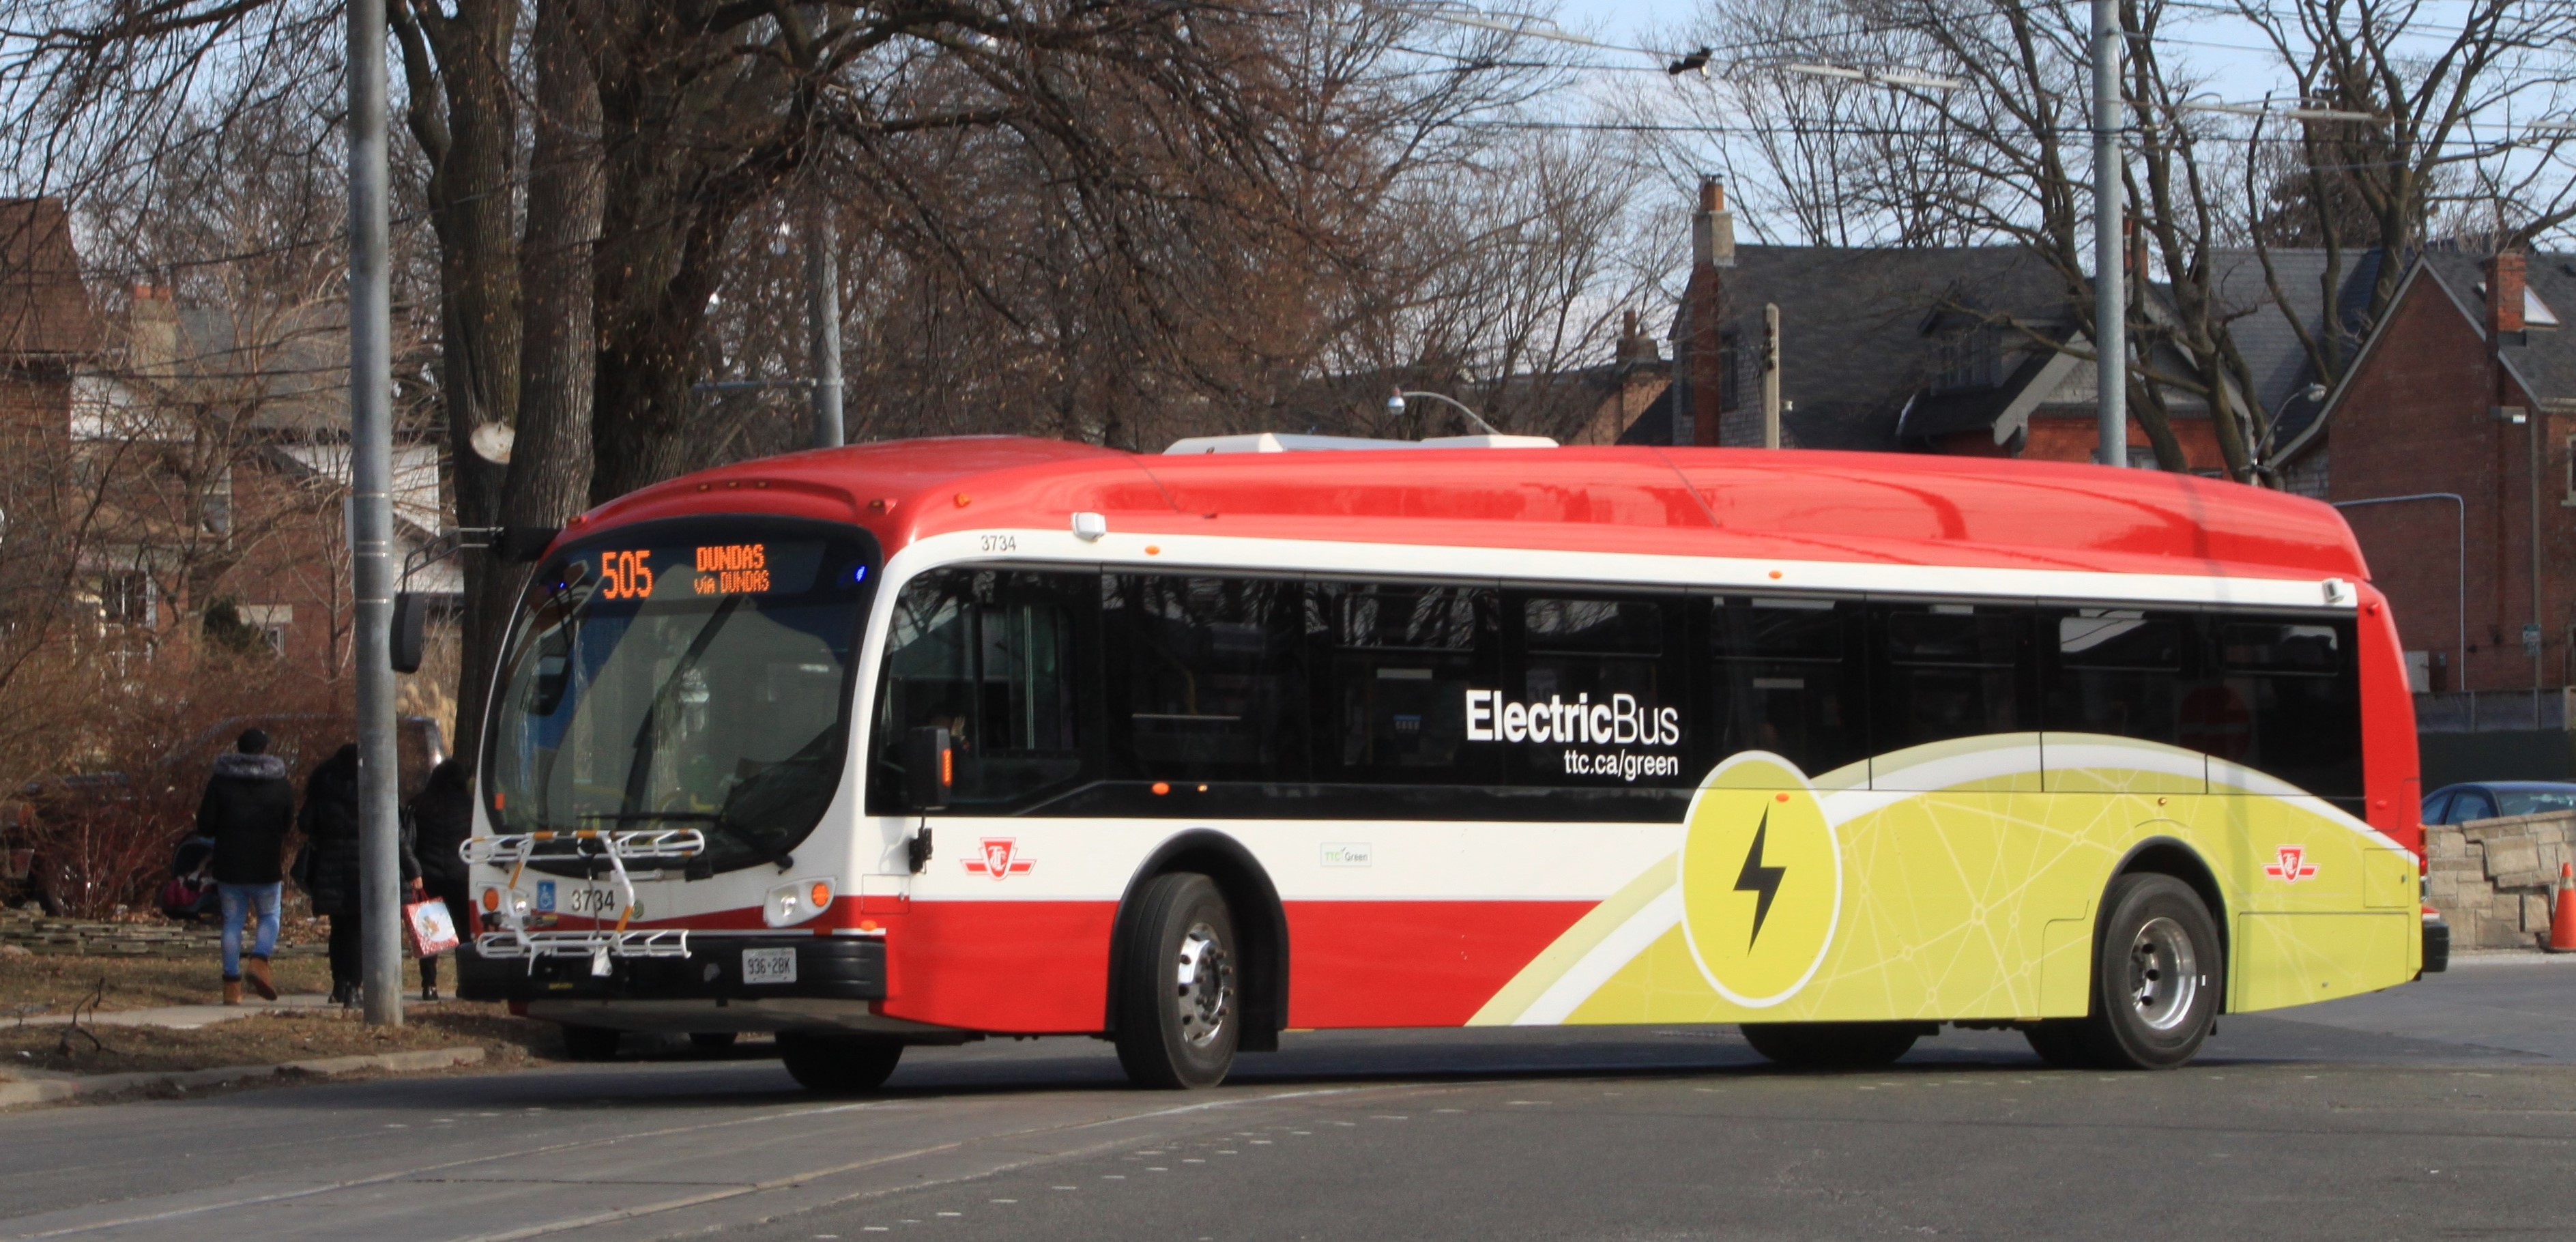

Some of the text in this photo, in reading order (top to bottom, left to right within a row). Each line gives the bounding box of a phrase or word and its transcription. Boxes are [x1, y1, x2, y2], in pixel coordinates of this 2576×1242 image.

[981, 534, 1017, 551] 3734
[696, 544, 765, 572] DUNDAS
[602, 549, 654, 600] 505
[720, 569, 770, 594] DUNDAS
[1466, 689, 1680, 746] ElectricBus
[1564, 749, 1679, 782] ttc.ca/green
[571, 889, 615, 912] 3734
